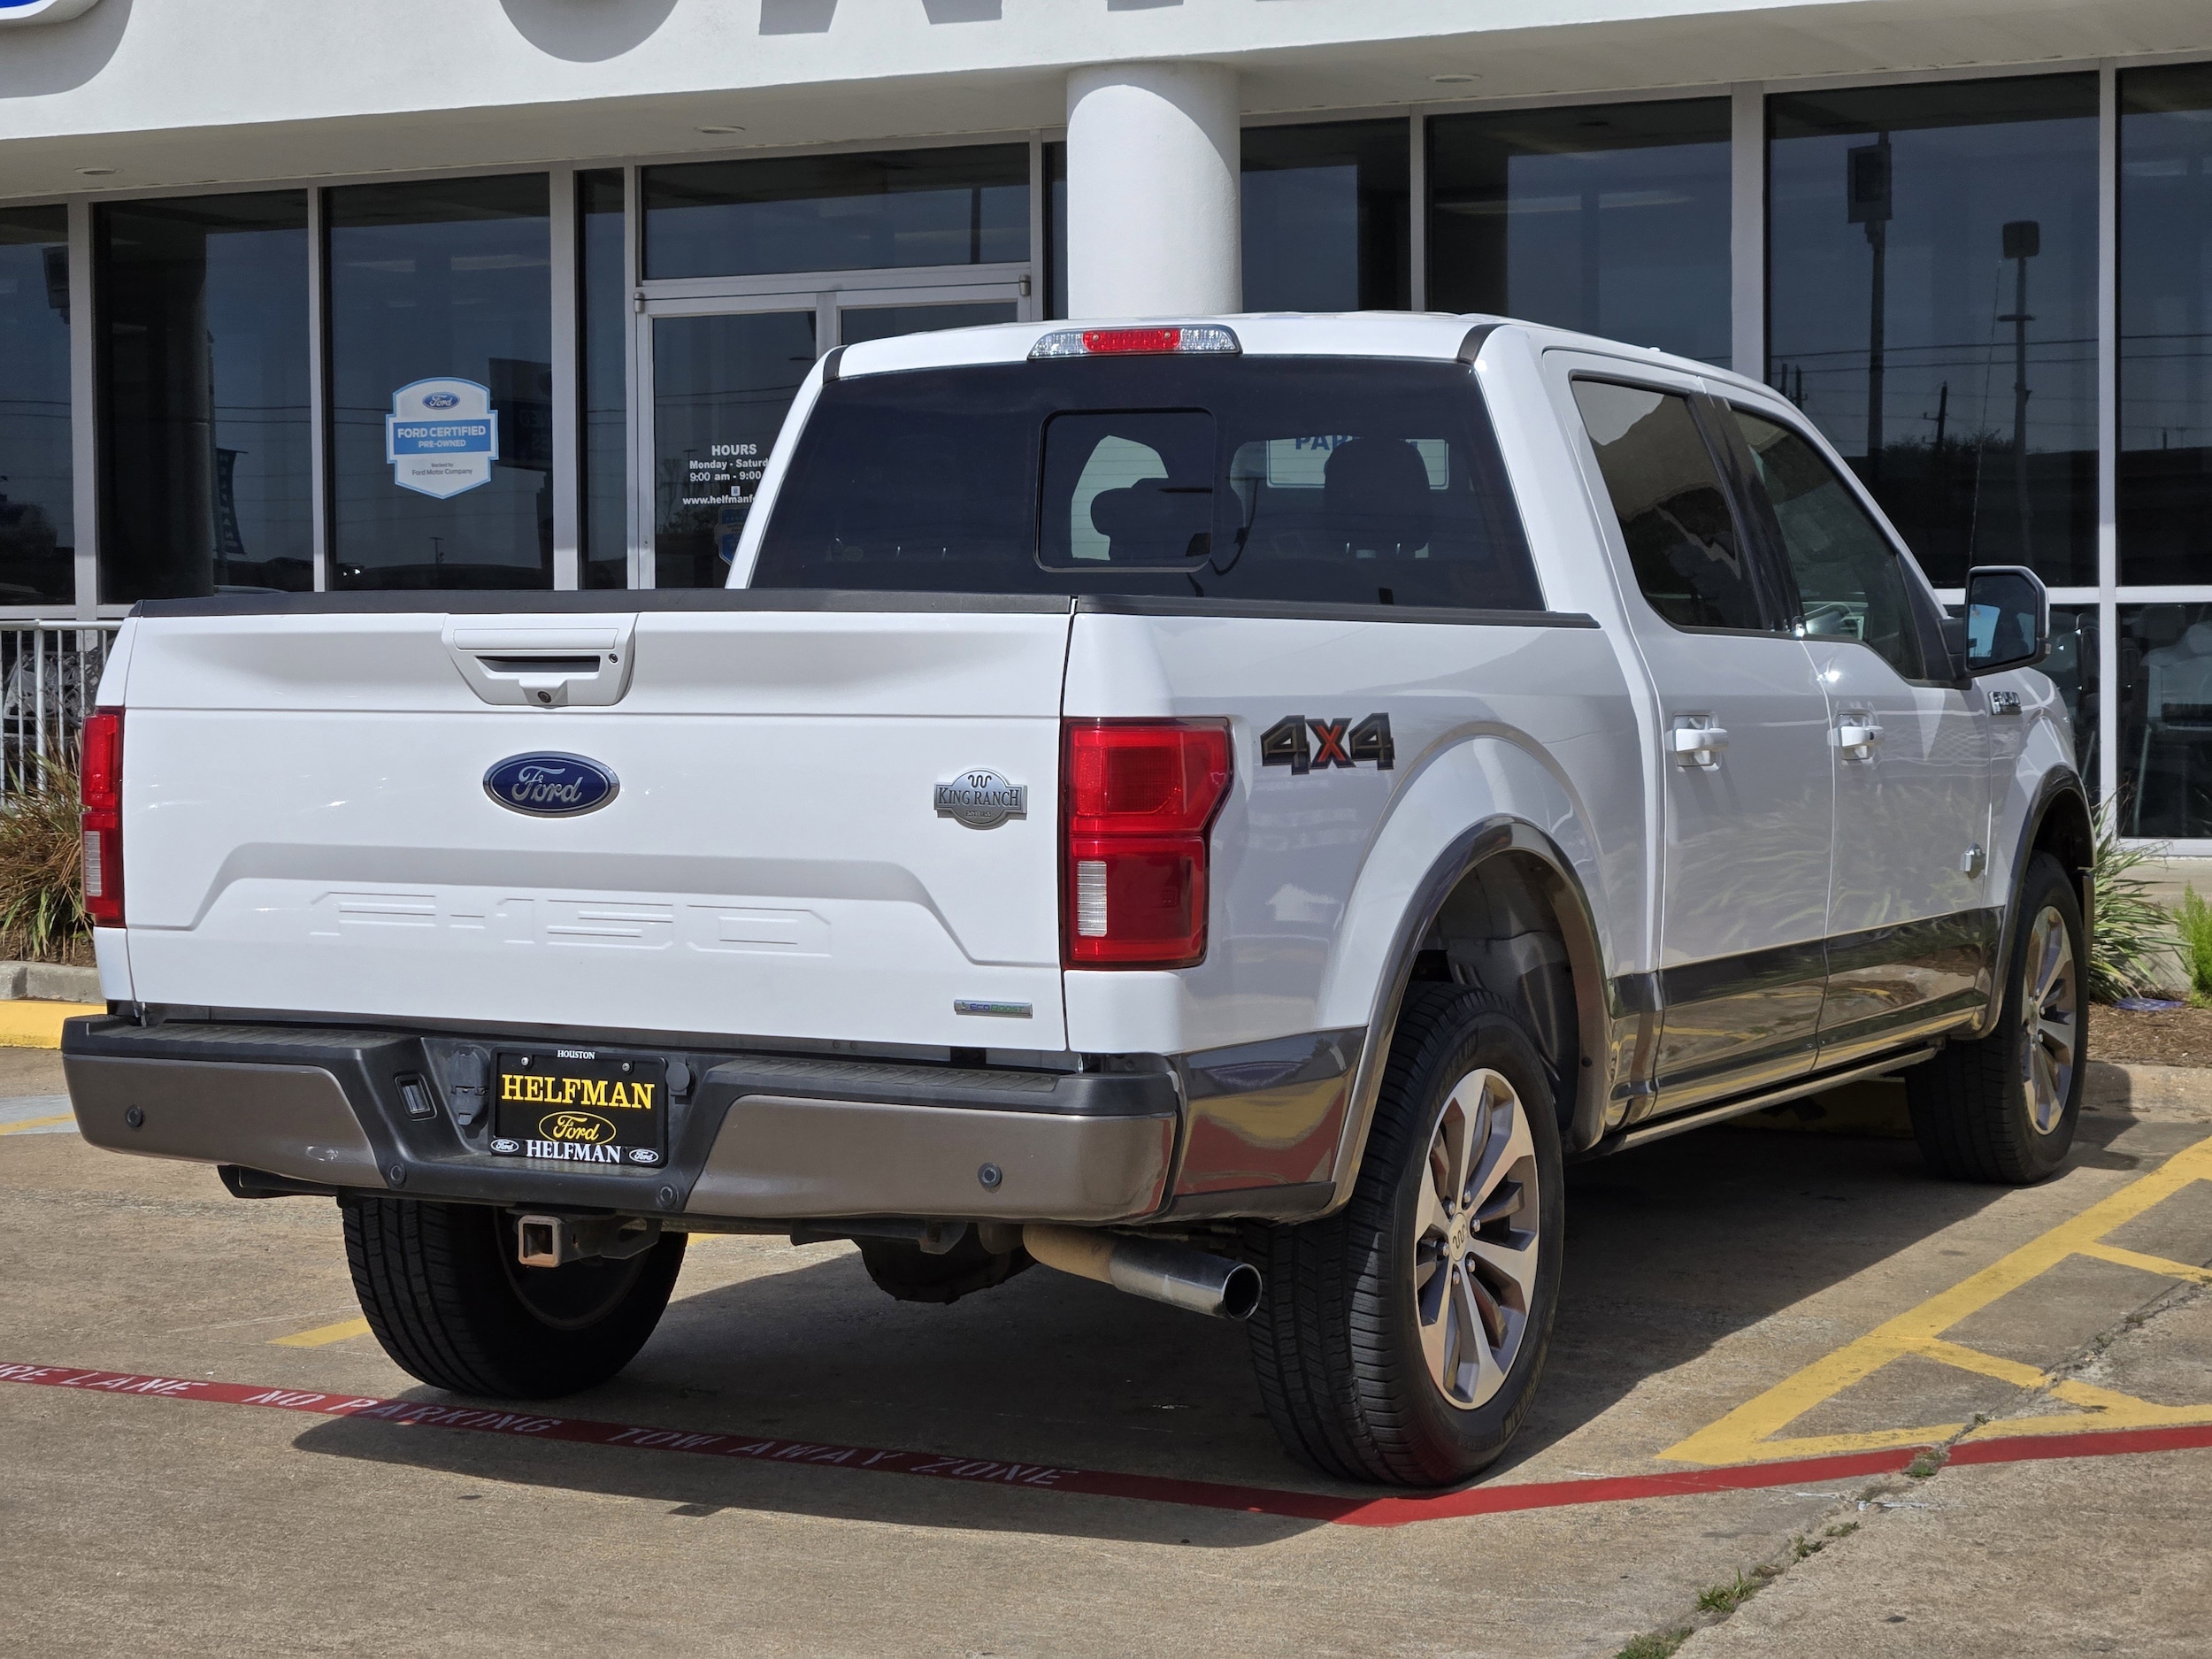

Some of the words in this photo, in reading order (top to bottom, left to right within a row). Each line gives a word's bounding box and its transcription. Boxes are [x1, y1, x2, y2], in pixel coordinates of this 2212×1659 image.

[430, 395, 452, 406] Ford
[398, 427, 427, 438] FORD
[430, 426, 486, 437] CERTIFIED
[711, 444, 757, 456] HOURS
[689, 460, 727, 470] Monday
[735, 458, 769, 467] Saturd
[690, 472, 710, 481] 9:00
[739, 471, 762, 480] 9:00
[682, 495, 755, 504] www.helfmanf
[511, 765, 583, 803] Ford
[938, 787, 971, 805] KING
[974, 788, 1019, 806] RANCH
[310, 890, 831, 957] F-150
[557, 1050, 595, 1060] HOUSTON
[501, 1073, 655, 1110] HELFMAN
[553, 1115, 600, 1141] Ford
[495, 1141, 514, 1150] Ford
[526, 1139, 621, 1164] HELFMAN
[634, 1151, 653, 1161] Ford
[0, 1363, 69, 1380] RE
[59, 1371, 209, 1395] LANE
[242, 1390, 326, 1408] NO
[324, 1397, 563, 1433] PARKING
[607, 1427, 726, 1448] TOW
[732, 1441, 905, 1466] AWAY
[910, 1456, 1079, 1486] ZONE
